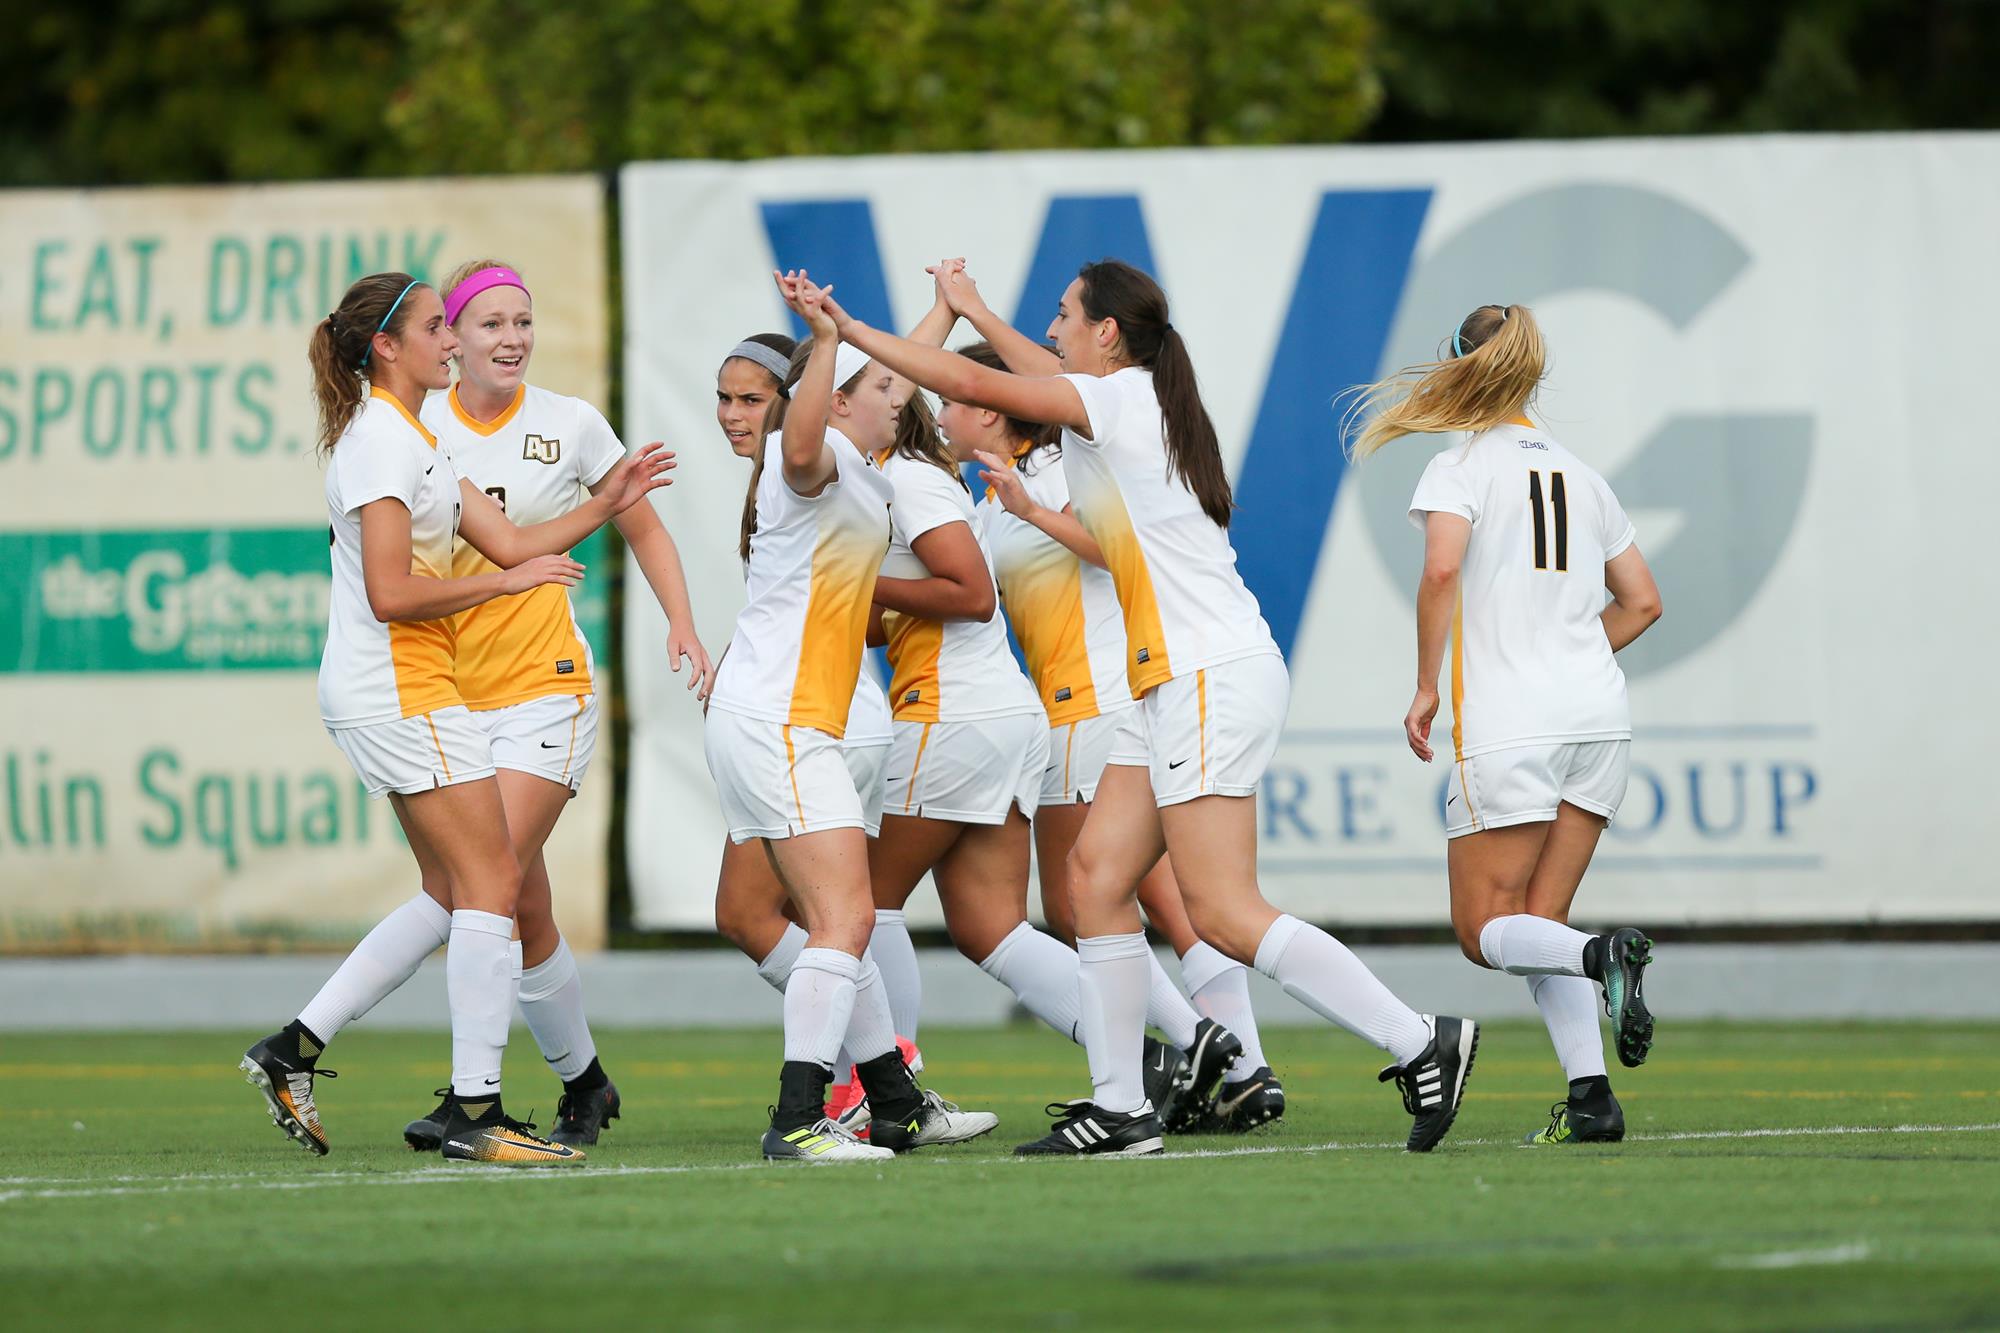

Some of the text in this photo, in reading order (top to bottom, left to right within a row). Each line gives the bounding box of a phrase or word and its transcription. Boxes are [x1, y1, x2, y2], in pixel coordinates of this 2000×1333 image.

[30, 237, 172, 342] EAT,
[523, 434, 561, 464] AU
[1529, 467, 1569, 573] 11
[137, 746, 412, 872] Squar
[1433, 758, 1820, 841] OUP
